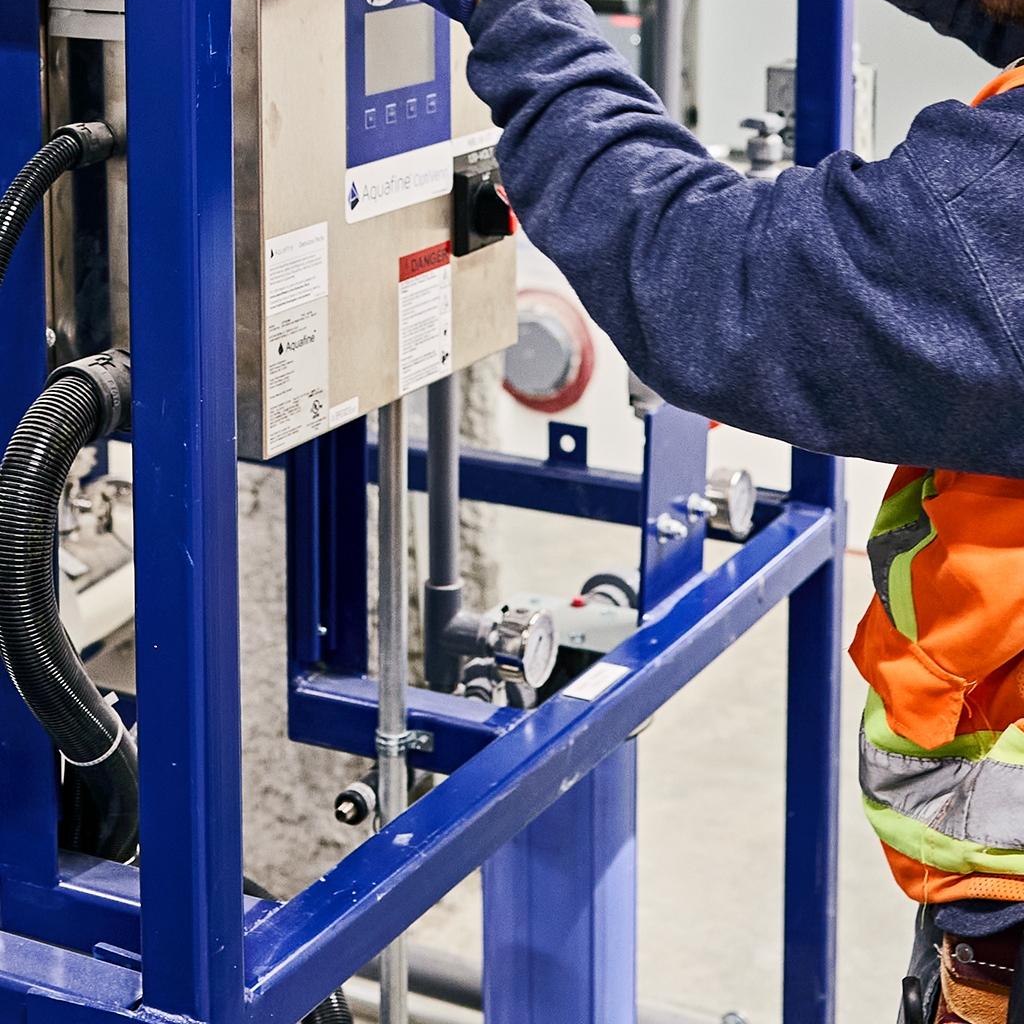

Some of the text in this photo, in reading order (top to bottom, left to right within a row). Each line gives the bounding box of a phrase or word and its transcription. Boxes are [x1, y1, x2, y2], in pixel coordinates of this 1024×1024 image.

[362, 174, 411, 200] Aquafine
[411, 248, 450, 273] DANGER
[286, 334, 316, 353] Aquafine
